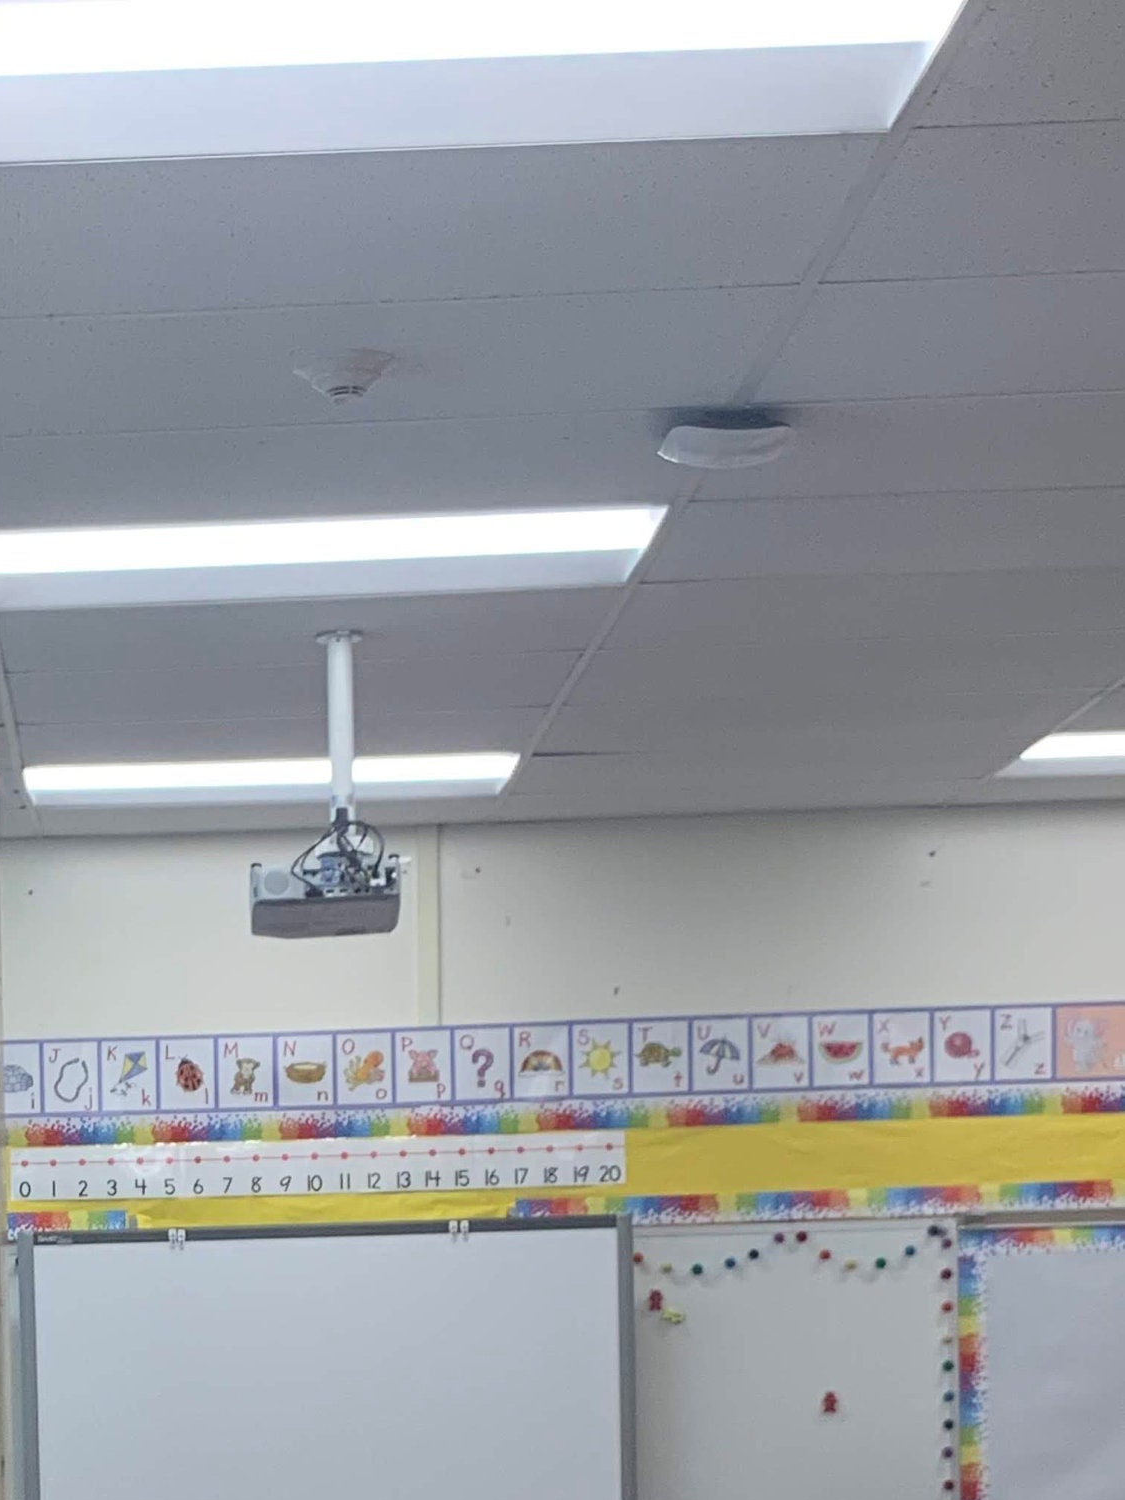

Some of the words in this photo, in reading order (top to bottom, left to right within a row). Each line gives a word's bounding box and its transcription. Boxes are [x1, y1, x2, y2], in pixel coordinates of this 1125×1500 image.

[48, 1048, 61, 1063] J
[107, 1046, 118, 1060] K
[165, 1044, 175, 1060] L
[223, 1042, 239, 1058] M
[283, 1040, 297, 1057] N
[342, 1038, 355, 1054] O
[402, 1037, 413, 1051] P
[460, 1035, 474, 1051] Q
[519, 1032, 531, 1048] R
[578, 1028, 590, 1046] S
[637, 1028, 653, 1042] T
[697, 1026, 711, 1041] U
[757, 1024, 771, 1039] V
[818, 1022, 836, 1036] W
[939, 1016, 951, 1031] Y
[1000, 1014, 1013, 1029] Z
[19, 1181, 31, 1197] 0
[78, 1180, 88, 1197] 2
[106, 1180, 117, 1196] 3
[135, 1179, 147, 1196] 4
[164, 1179, 176, 1195] 5
[193, 1179, 204, 1194] 6
[223, 1178, 233, 1194] 7
[251, 1177, 261, 1192] 8
[280, 1176, 291, 1192] 9
[307, 1174, 323, 1192] 10
[340, 1173, 351, 1190] 11
[367, 1173, 381, 1189] 12
[397, 1171, 411, 1188] 13
[425, 1171, 441, 1187] 14
[455, 1169, 469, 1186] 15
[485, 1169, 500, 1185] 16
[514, 1168, 528, 1184] 17
[544, 1167, 558, 1183] 18
[574, 1166, 589, 1182] 19
[599, 1165, 621, 1182] 20
